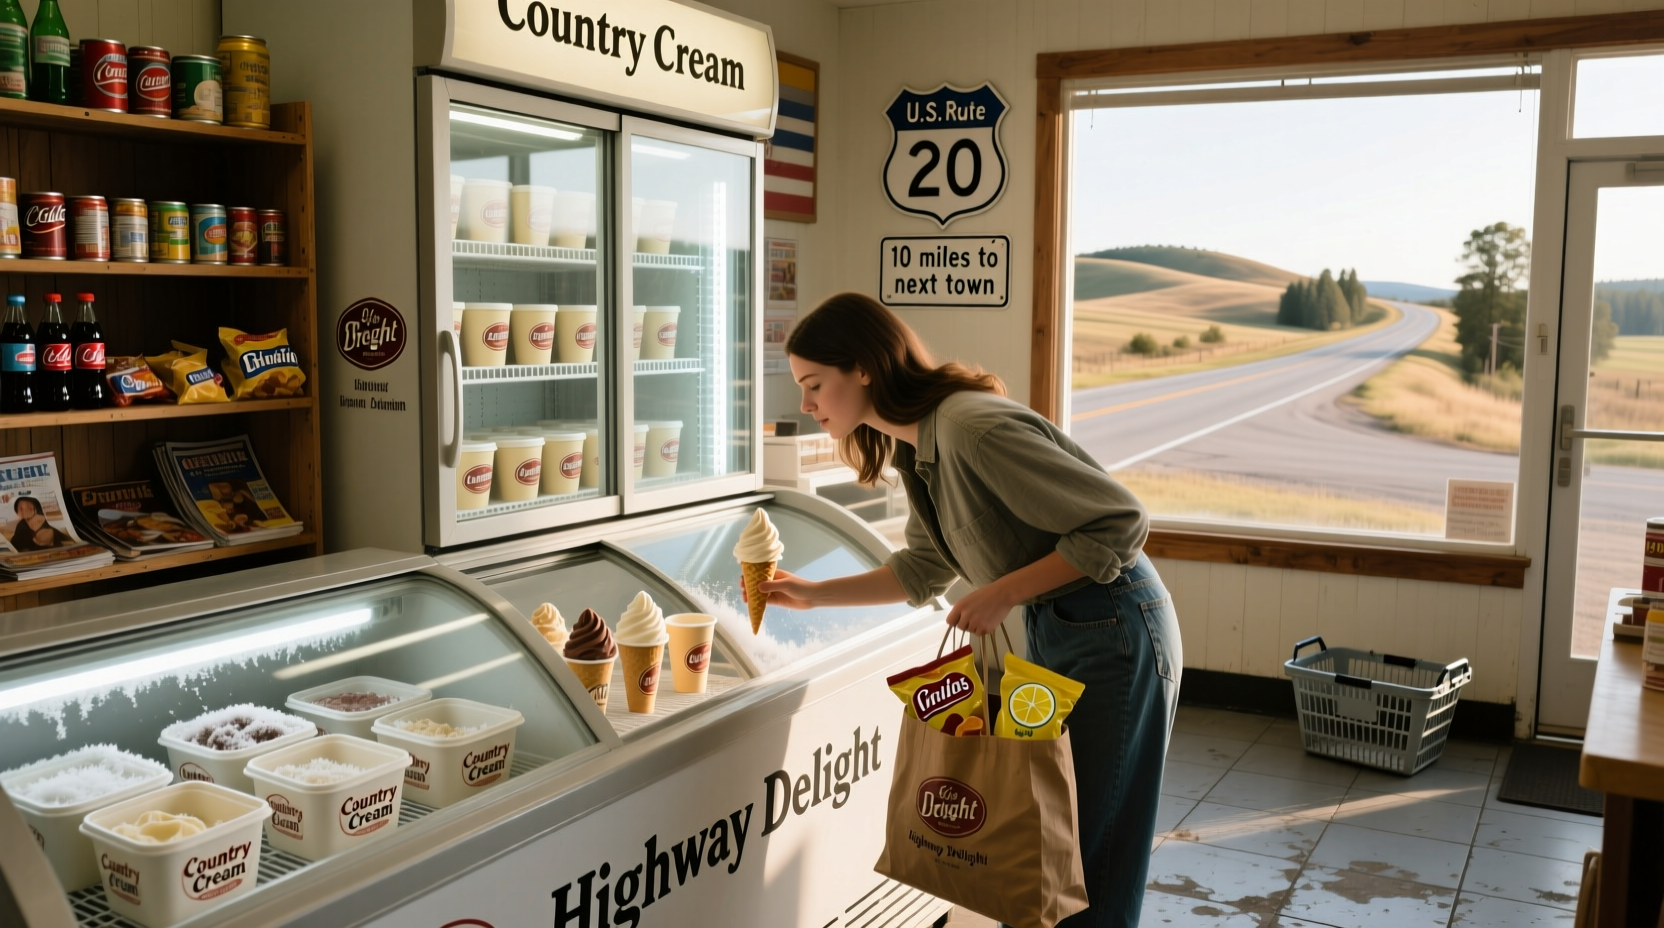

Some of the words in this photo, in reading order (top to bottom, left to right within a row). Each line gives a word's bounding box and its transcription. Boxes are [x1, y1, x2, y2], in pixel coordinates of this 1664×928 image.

[498, 0, 647, 77] Country
[653, 24, 745, 91] Cream
[908, 138, 982, 198] 20
[891, 245, 912, 268] 10
[919, 245, 971, 268] miles
[978, 246, 998, 268] to
[895, 273, 938, 295] next
[945, 273, 995, 296] town
[462, 743, 511, 769] Country
[341, 785, 398, 816] Country
[348, 803, 393, 830] Cream
[551, 802, 754, 928] Highway
[761, 725, 882, 838] Delight
[183, 841, 252, 878] Country
[193, 862, 246, 894] Cream
